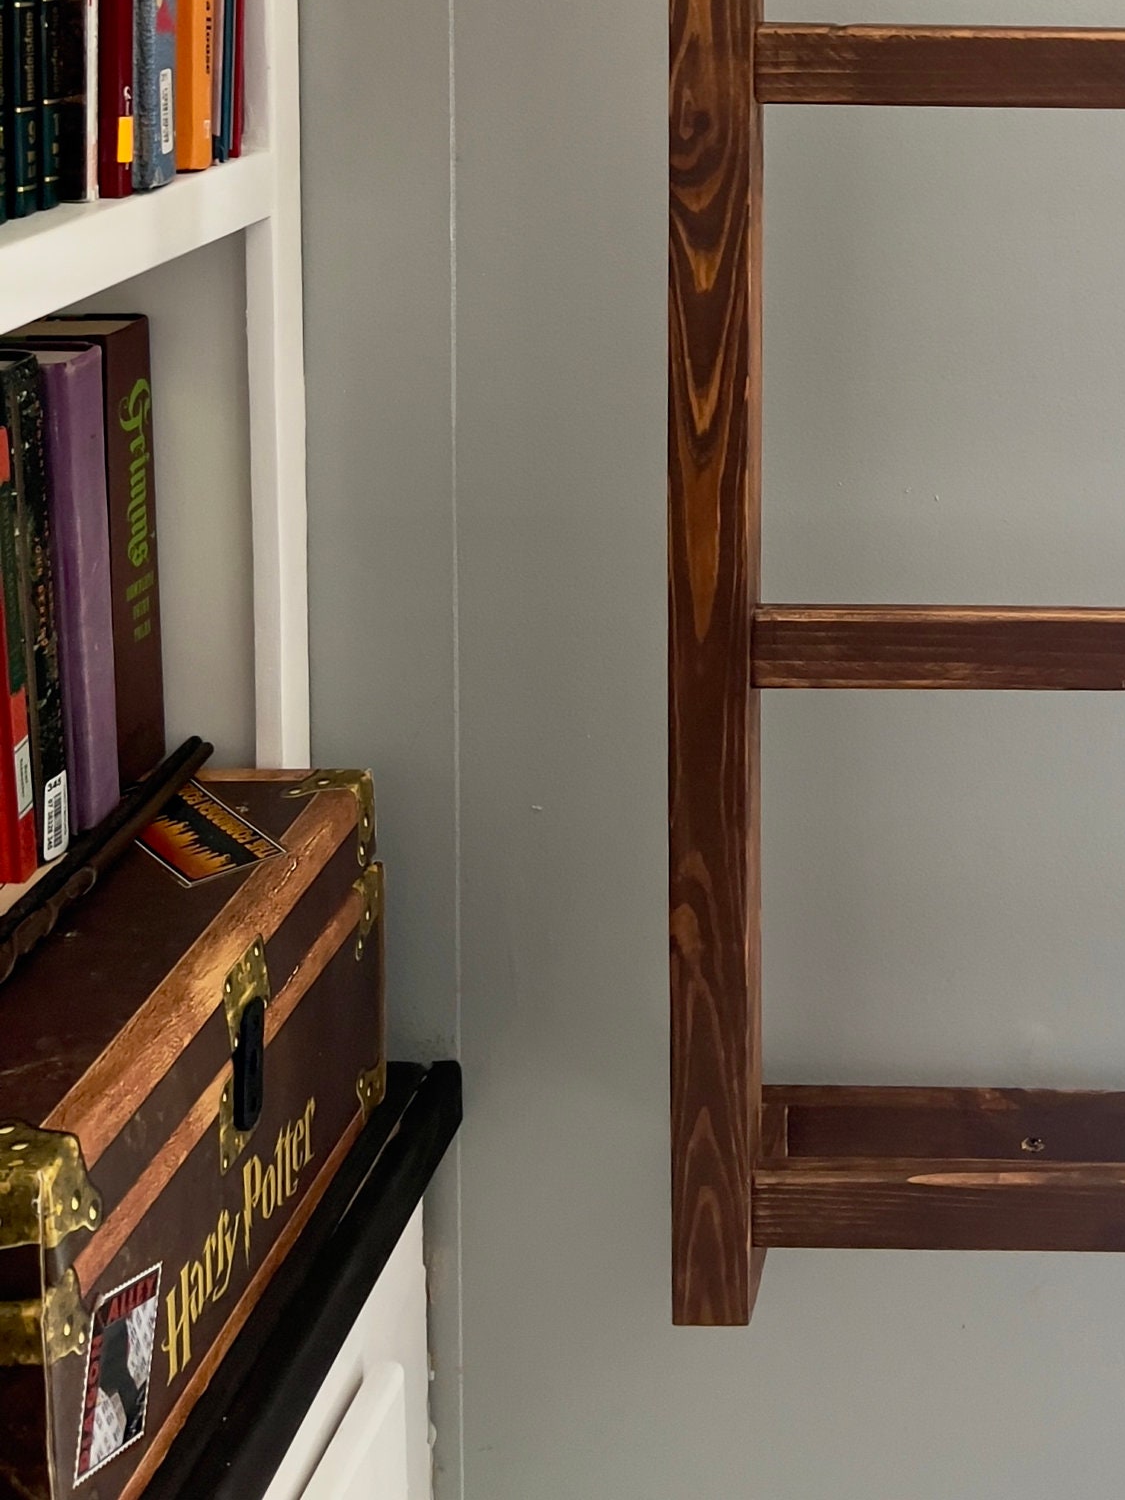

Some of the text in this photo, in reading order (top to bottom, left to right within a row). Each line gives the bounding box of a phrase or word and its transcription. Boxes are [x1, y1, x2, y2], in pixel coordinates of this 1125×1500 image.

[204, 16, 214, 76] House
[161, 1097, 315, 1386] Harry Potter
